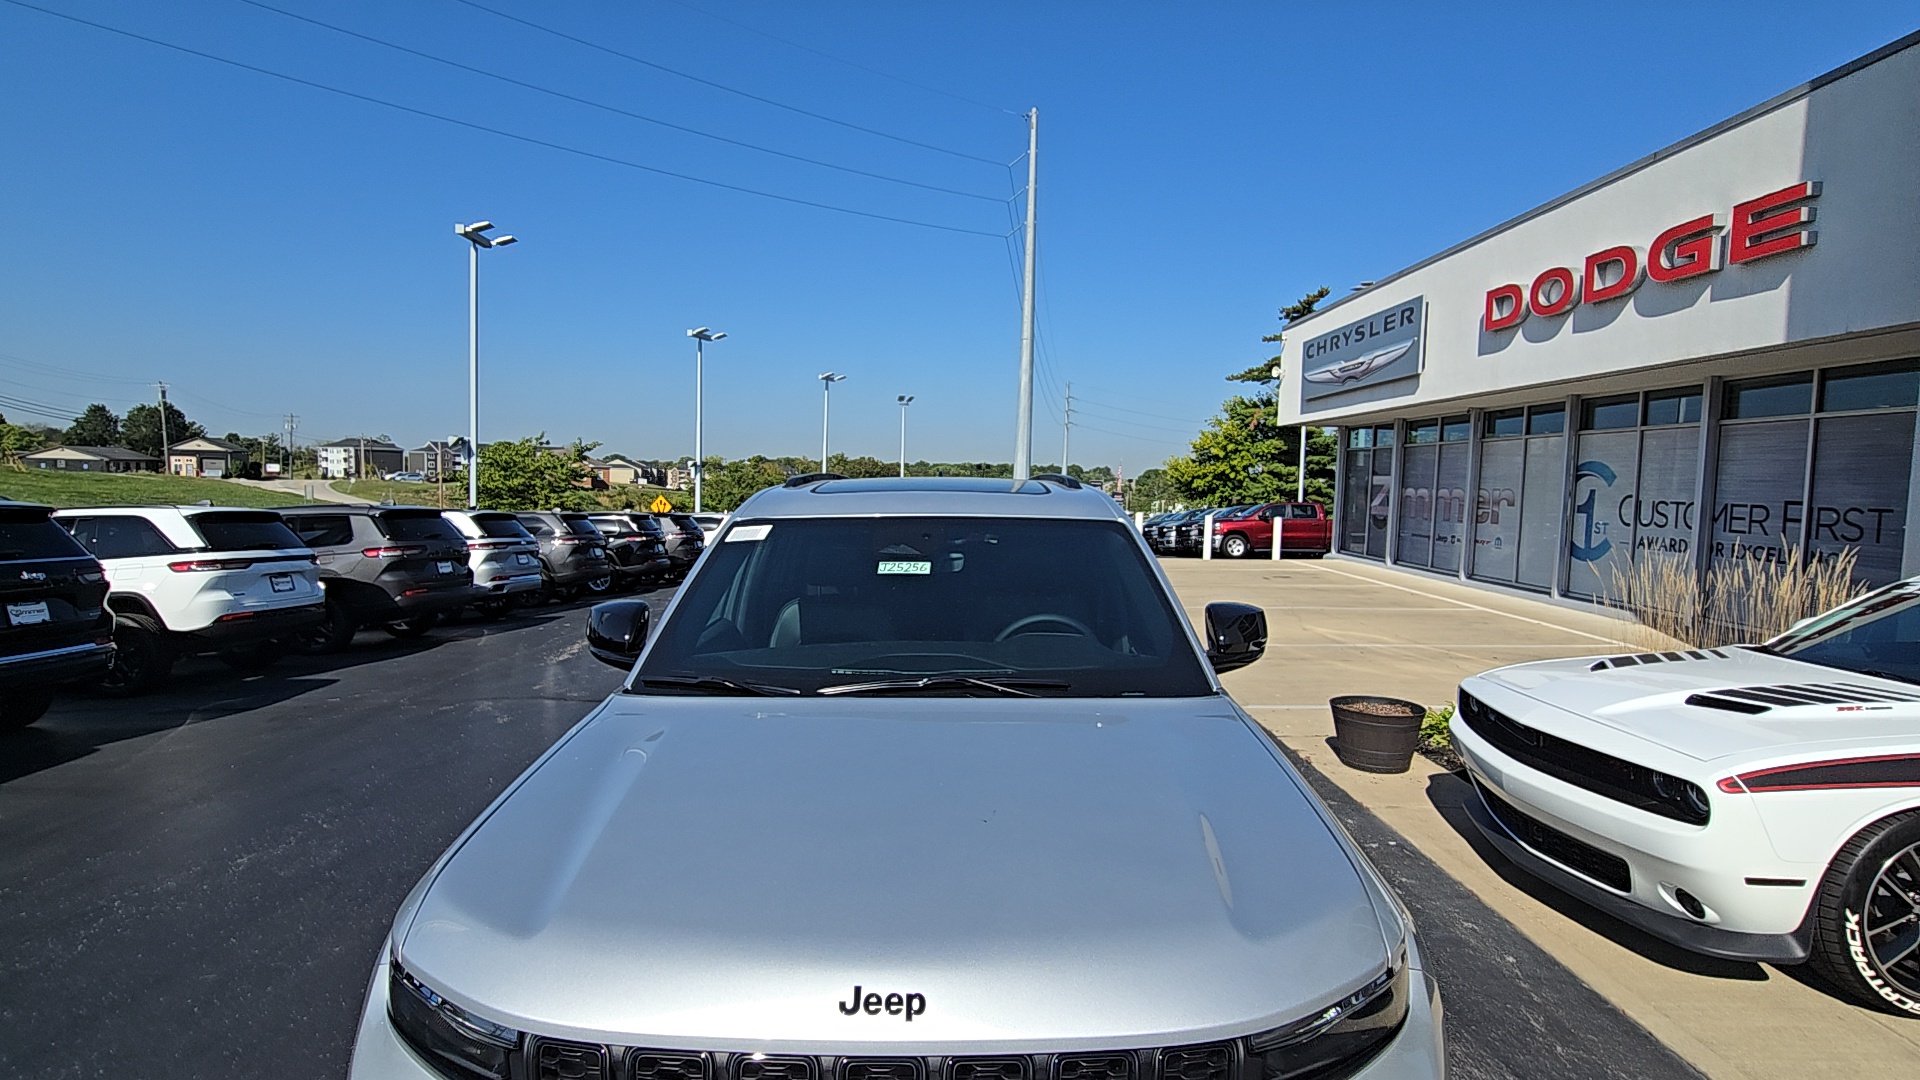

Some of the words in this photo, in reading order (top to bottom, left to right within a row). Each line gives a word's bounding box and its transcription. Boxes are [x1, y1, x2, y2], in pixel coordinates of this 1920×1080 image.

[1484, 181, 1813, 332] DODGE
[1306, 306, 1415, 359] CHRYSLER
[1371, 475, 1515, 525] Zmmer
[1637, 535, 1688, 553] AWARD
[20, 571, 47, 580] Jeep
[839, 985, 926, 1022] Jeep
